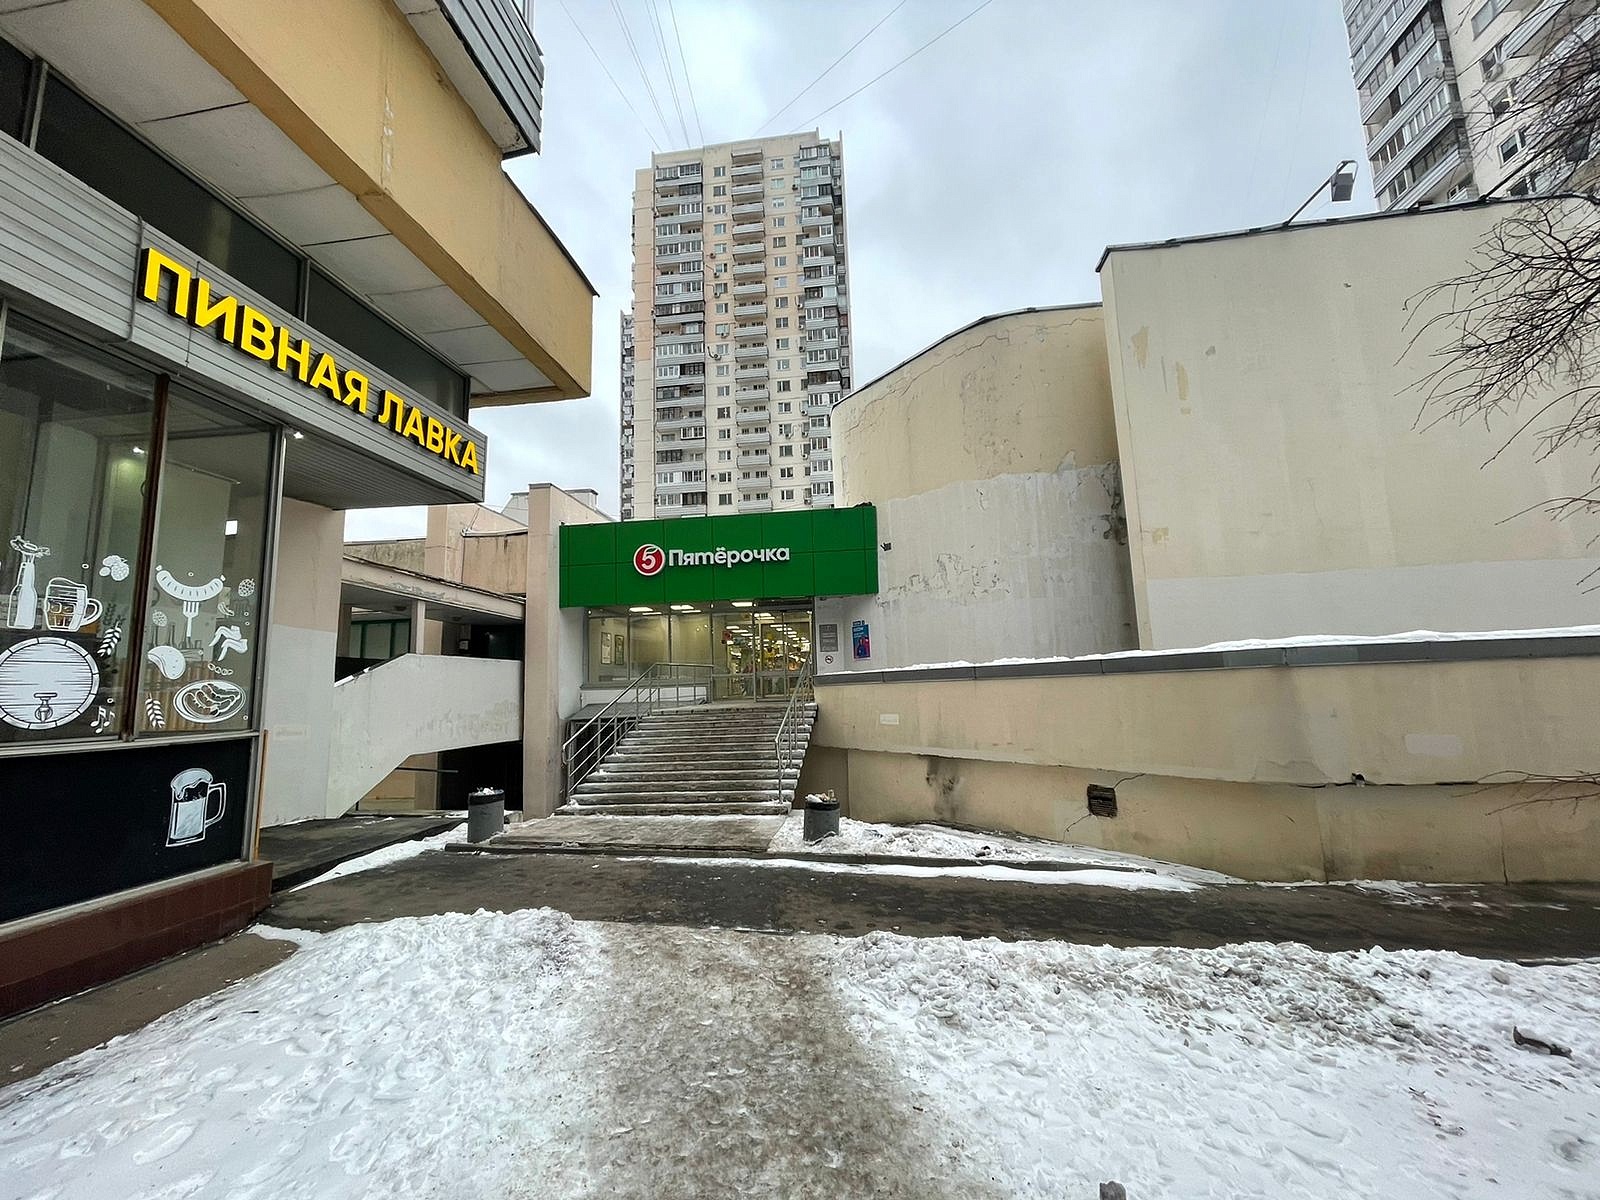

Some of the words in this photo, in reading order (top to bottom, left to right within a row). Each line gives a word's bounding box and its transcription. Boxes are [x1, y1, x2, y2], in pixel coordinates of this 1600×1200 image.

[144, 247, 369, 413] ПИВНАЯ
[379, 389, 479, 475] ЛАВКА
[668, 547, 790, 568] Пятёрочка
